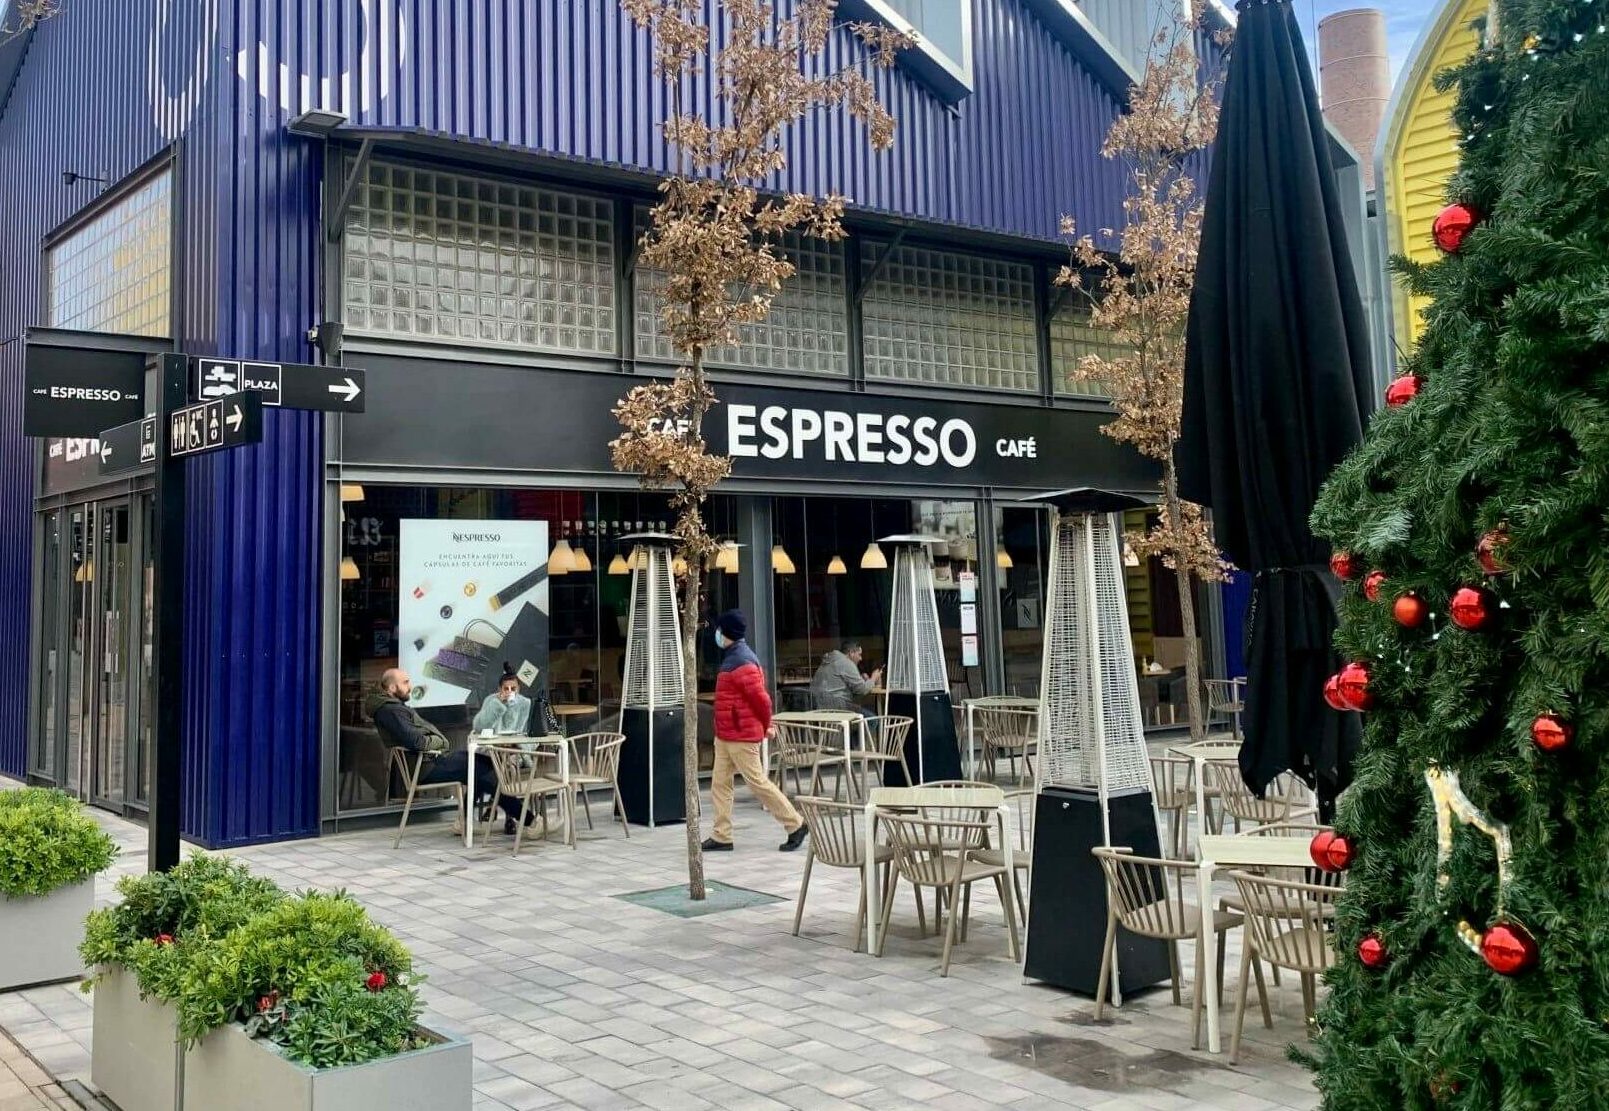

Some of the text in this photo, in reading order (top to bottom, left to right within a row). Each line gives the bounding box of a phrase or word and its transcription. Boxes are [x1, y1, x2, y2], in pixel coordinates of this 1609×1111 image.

[244, 379, 279, 390] PLAZA
[50, 386, 121, 401] ESPRESSO
[647, 404, 1037, 467] CAF ESPRESSO CAFÉ
[452, 532, 501, 542] NESPRESSO
